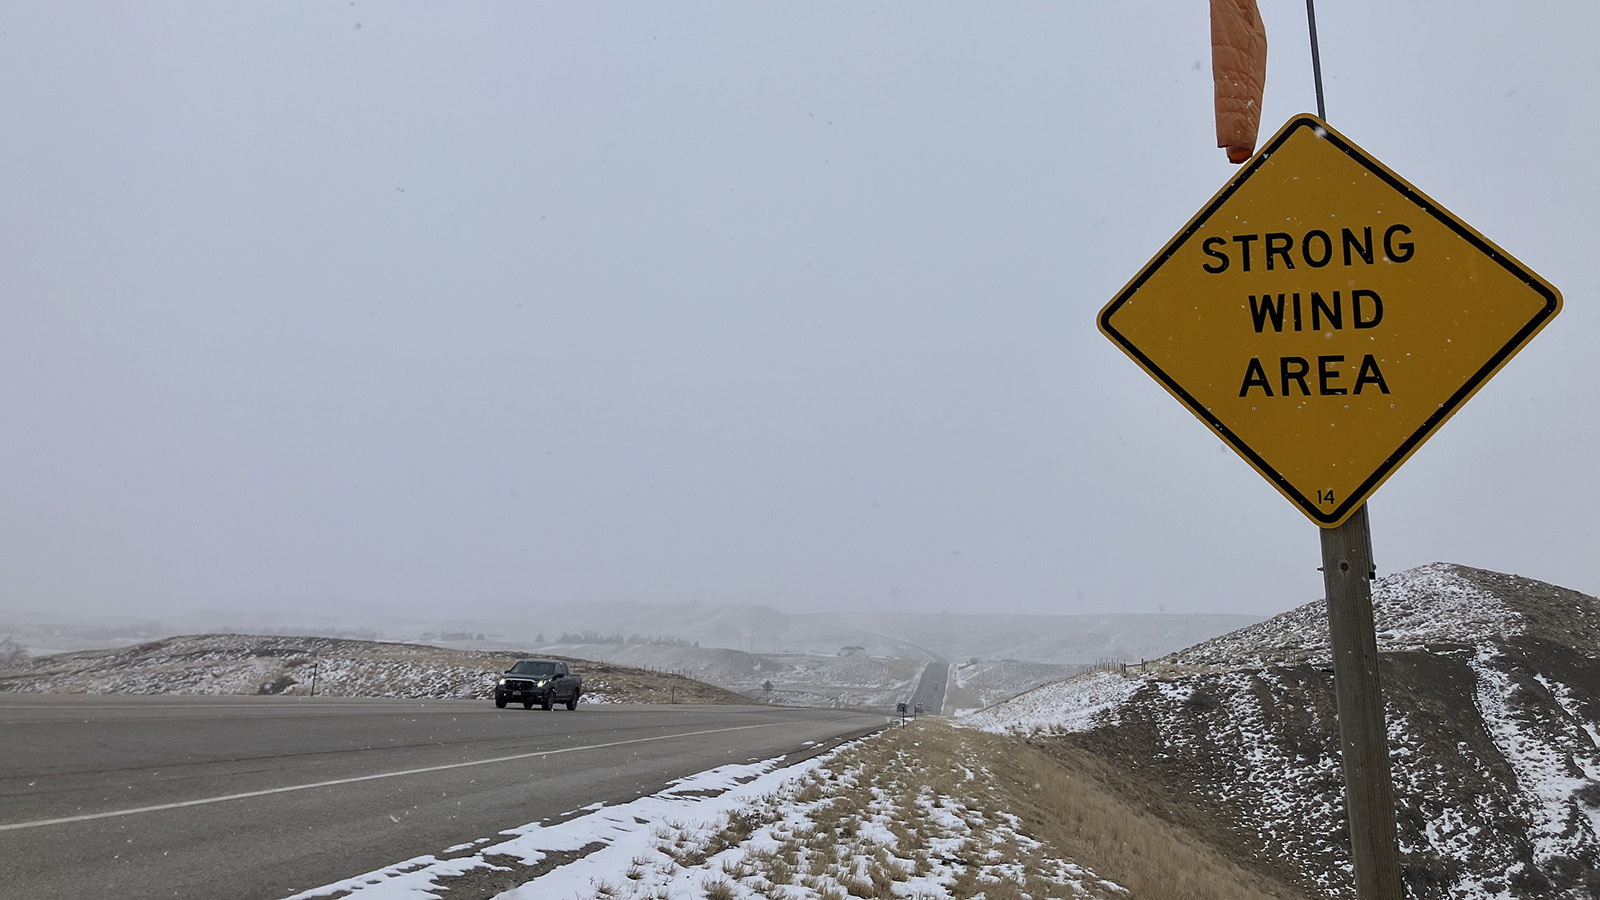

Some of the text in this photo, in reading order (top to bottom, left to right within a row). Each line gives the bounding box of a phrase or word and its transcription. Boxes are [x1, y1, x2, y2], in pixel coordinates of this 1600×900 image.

[1201, 224, 1415, 274] STRONG
[1248, 289, 1384, 333] WIND
[1238, 353, 1391, 398] AREA
[1317, 490, 1335, 505] 14
